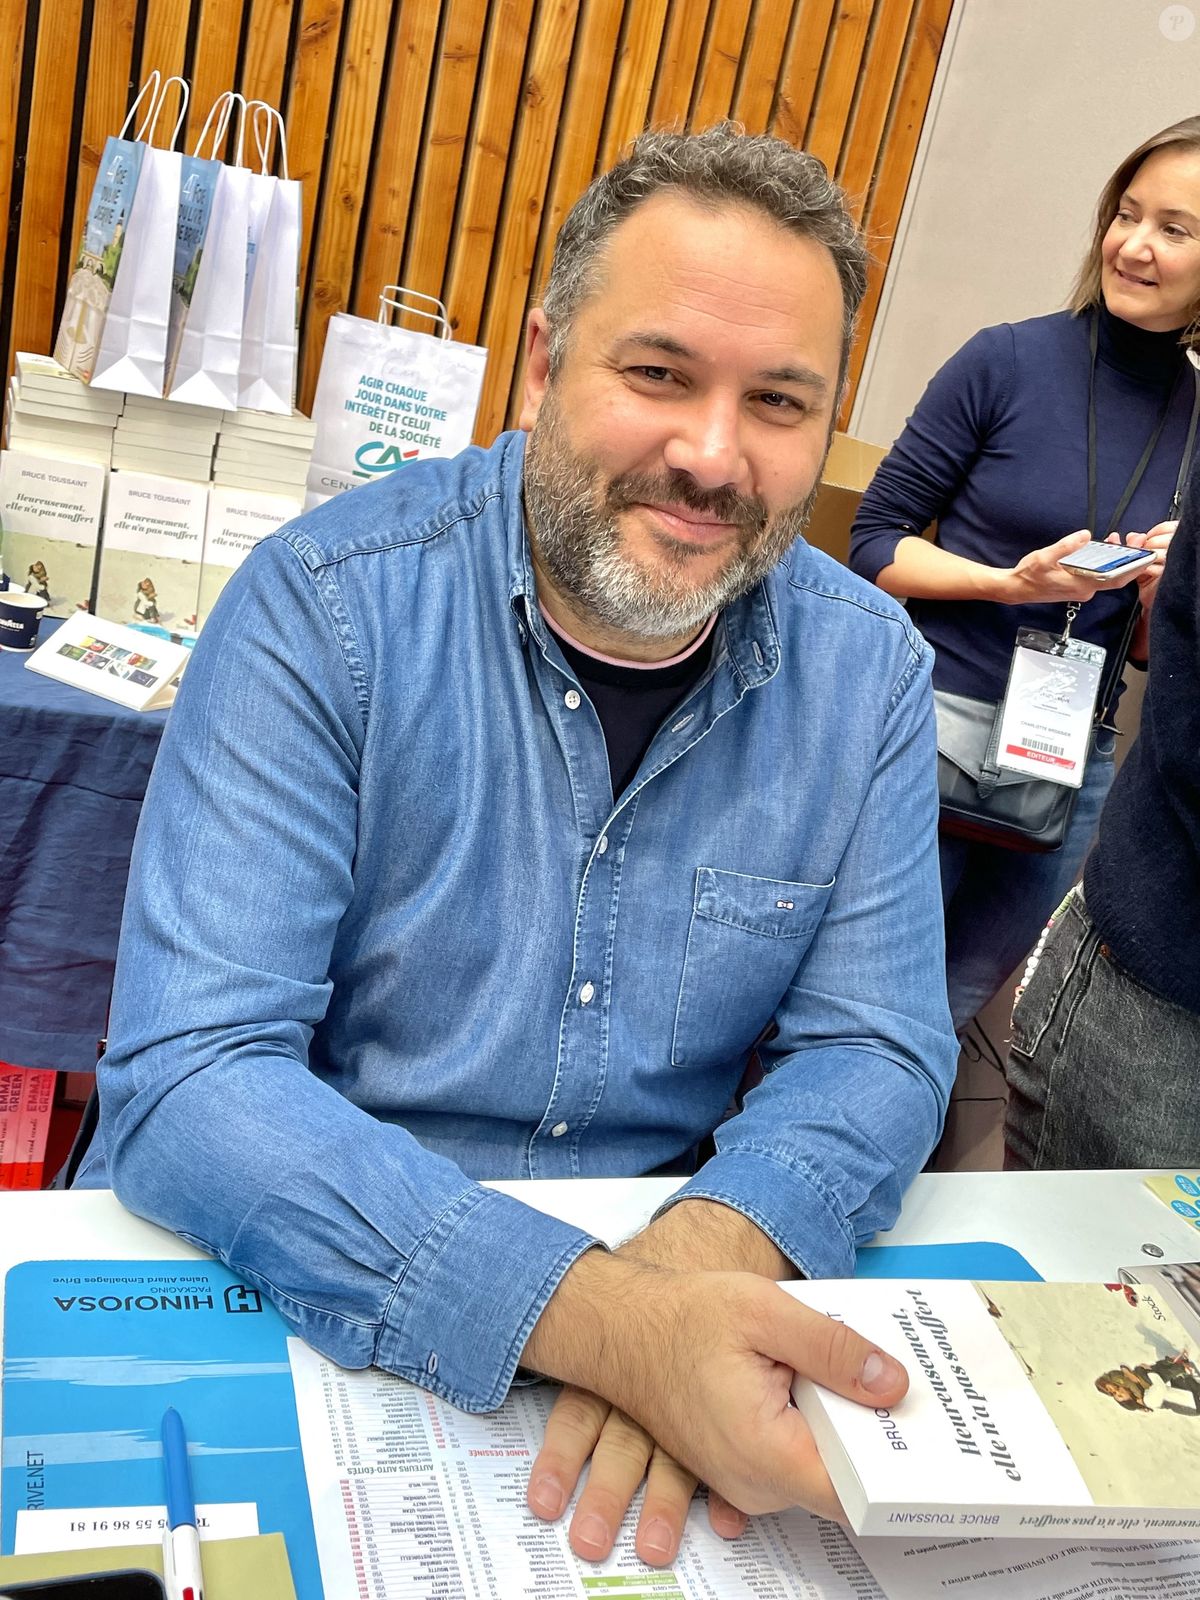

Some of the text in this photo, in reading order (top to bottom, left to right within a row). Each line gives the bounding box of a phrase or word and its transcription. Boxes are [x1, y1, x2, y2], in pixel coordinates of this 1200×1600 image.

[359, 375, 428, 402] AGIR CHAQUE
[355, 389, 447, 421] JOUR DANS VOTRE
[344, 399, 431, 431] INTÉRÊT ET CELUI
[369, 421, 442, 448] DE LA SOCIÉTÉ
[21, 470, 88, 487] BRUCE TOUSSAINT
[321, 477, 357, 490] CENT
[128, 490, 191, 505] BRUCE TOUSSAINT
[5, 502, 23, 511] elle
[38, 509, 57, 517] pas
[57, 512, 94, 523] souffert
[226, 507, 285, 522] BRUCE TOUSSAINT
[113, 521, 131, 530] elle
[145, 527, 162, 535] pas
[163, 530, 198, 540] souffert
[212, 537, 228, 546] elle
[1027, 750, 1056, 765] EDITEUR
[0, 1075, 11, 1112] EMMA
[9, 1074, 23, 1112] GREEN
[26, 1075, 40, 1112] EMMA
[38, 1074, 53, 1112] GREEN
[84, 1276, 145, 1284] Emballages
[150, 1286, 211, 1294] PACKAGING
[53, 1295, 214, 1312] HINOJOSA
[1141, 1295, 1166, 1321] Stock
[891, 1307, 982, 1456] Heureusement,
[905, 1288, 1021, 1481] elle n'a pas souffert
[874, 1407, 908, 1450] BRUC
[468, 1450, 504, 1458] DESSINÉE
[346, 1464, 434, 1475] AUTEURS AUTO-ÉDITÉS
[27, 1450, 44, 1511] RIVE.NET
[69, 1519, 169, 1532] 5 55 86 91 81
[887, 1513, 1000, 1524] BRUCE TOUSSAINT
[1019, 1515, 1200, 1529] eusement, elle n'a pas souffert
[915, 1544, 938, 1554] posées
[938, 1539, 969, 1550] questions
[1059, 1545, 1089, 1558] VISIBLE
[1139, 1543, 1154, 1551] PAS
[903, 1549, 915, 1557] par
[1046, 1552, 1059, 1563] OU
[988, 1569, 1004, 1577] mais
[1005, 1558, 1046, 1574] INVISIBLE
[947, 1576, 971, 1585] arriver
[971, 1571, 987, 1580] peut
[1052, 1586, 1081, 1600] travaille
[1097, 1586, 1120, 1595] retraite
